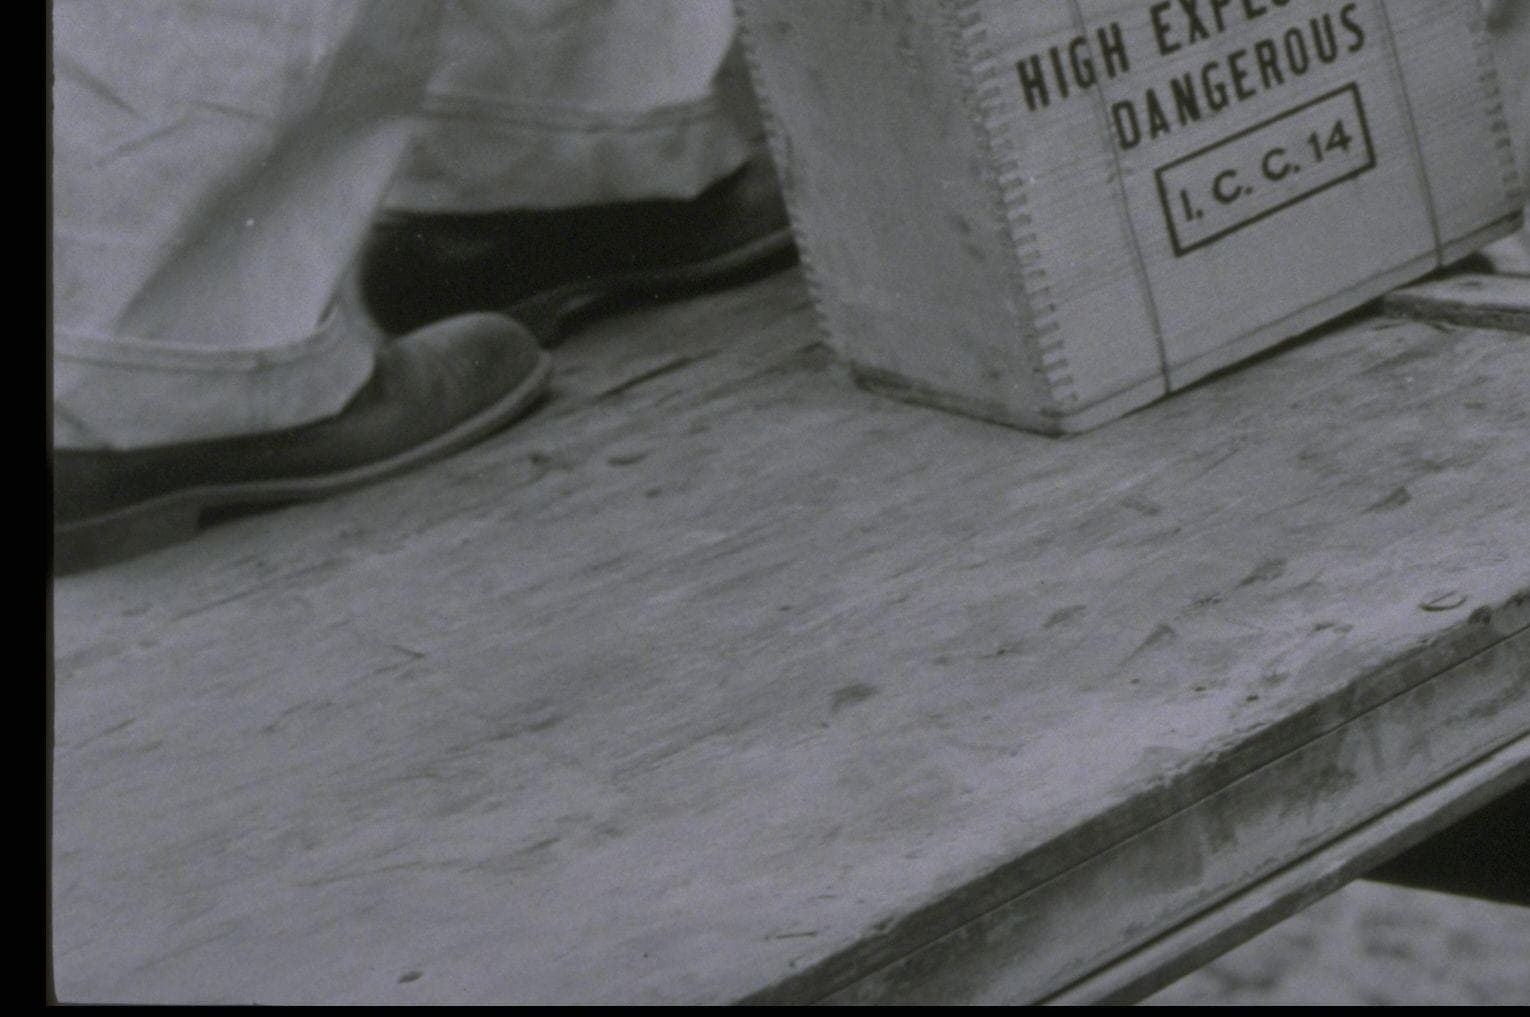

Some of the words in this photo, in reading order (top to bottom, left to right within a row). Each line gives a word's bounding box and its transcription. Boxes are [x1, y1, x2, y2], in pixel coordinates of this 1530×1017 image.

[1014, 19, 1131, 113] HIGH
[1110, 2, 1366, 152] DANGEROUS
[1306, 119, 1352, 164] 14
